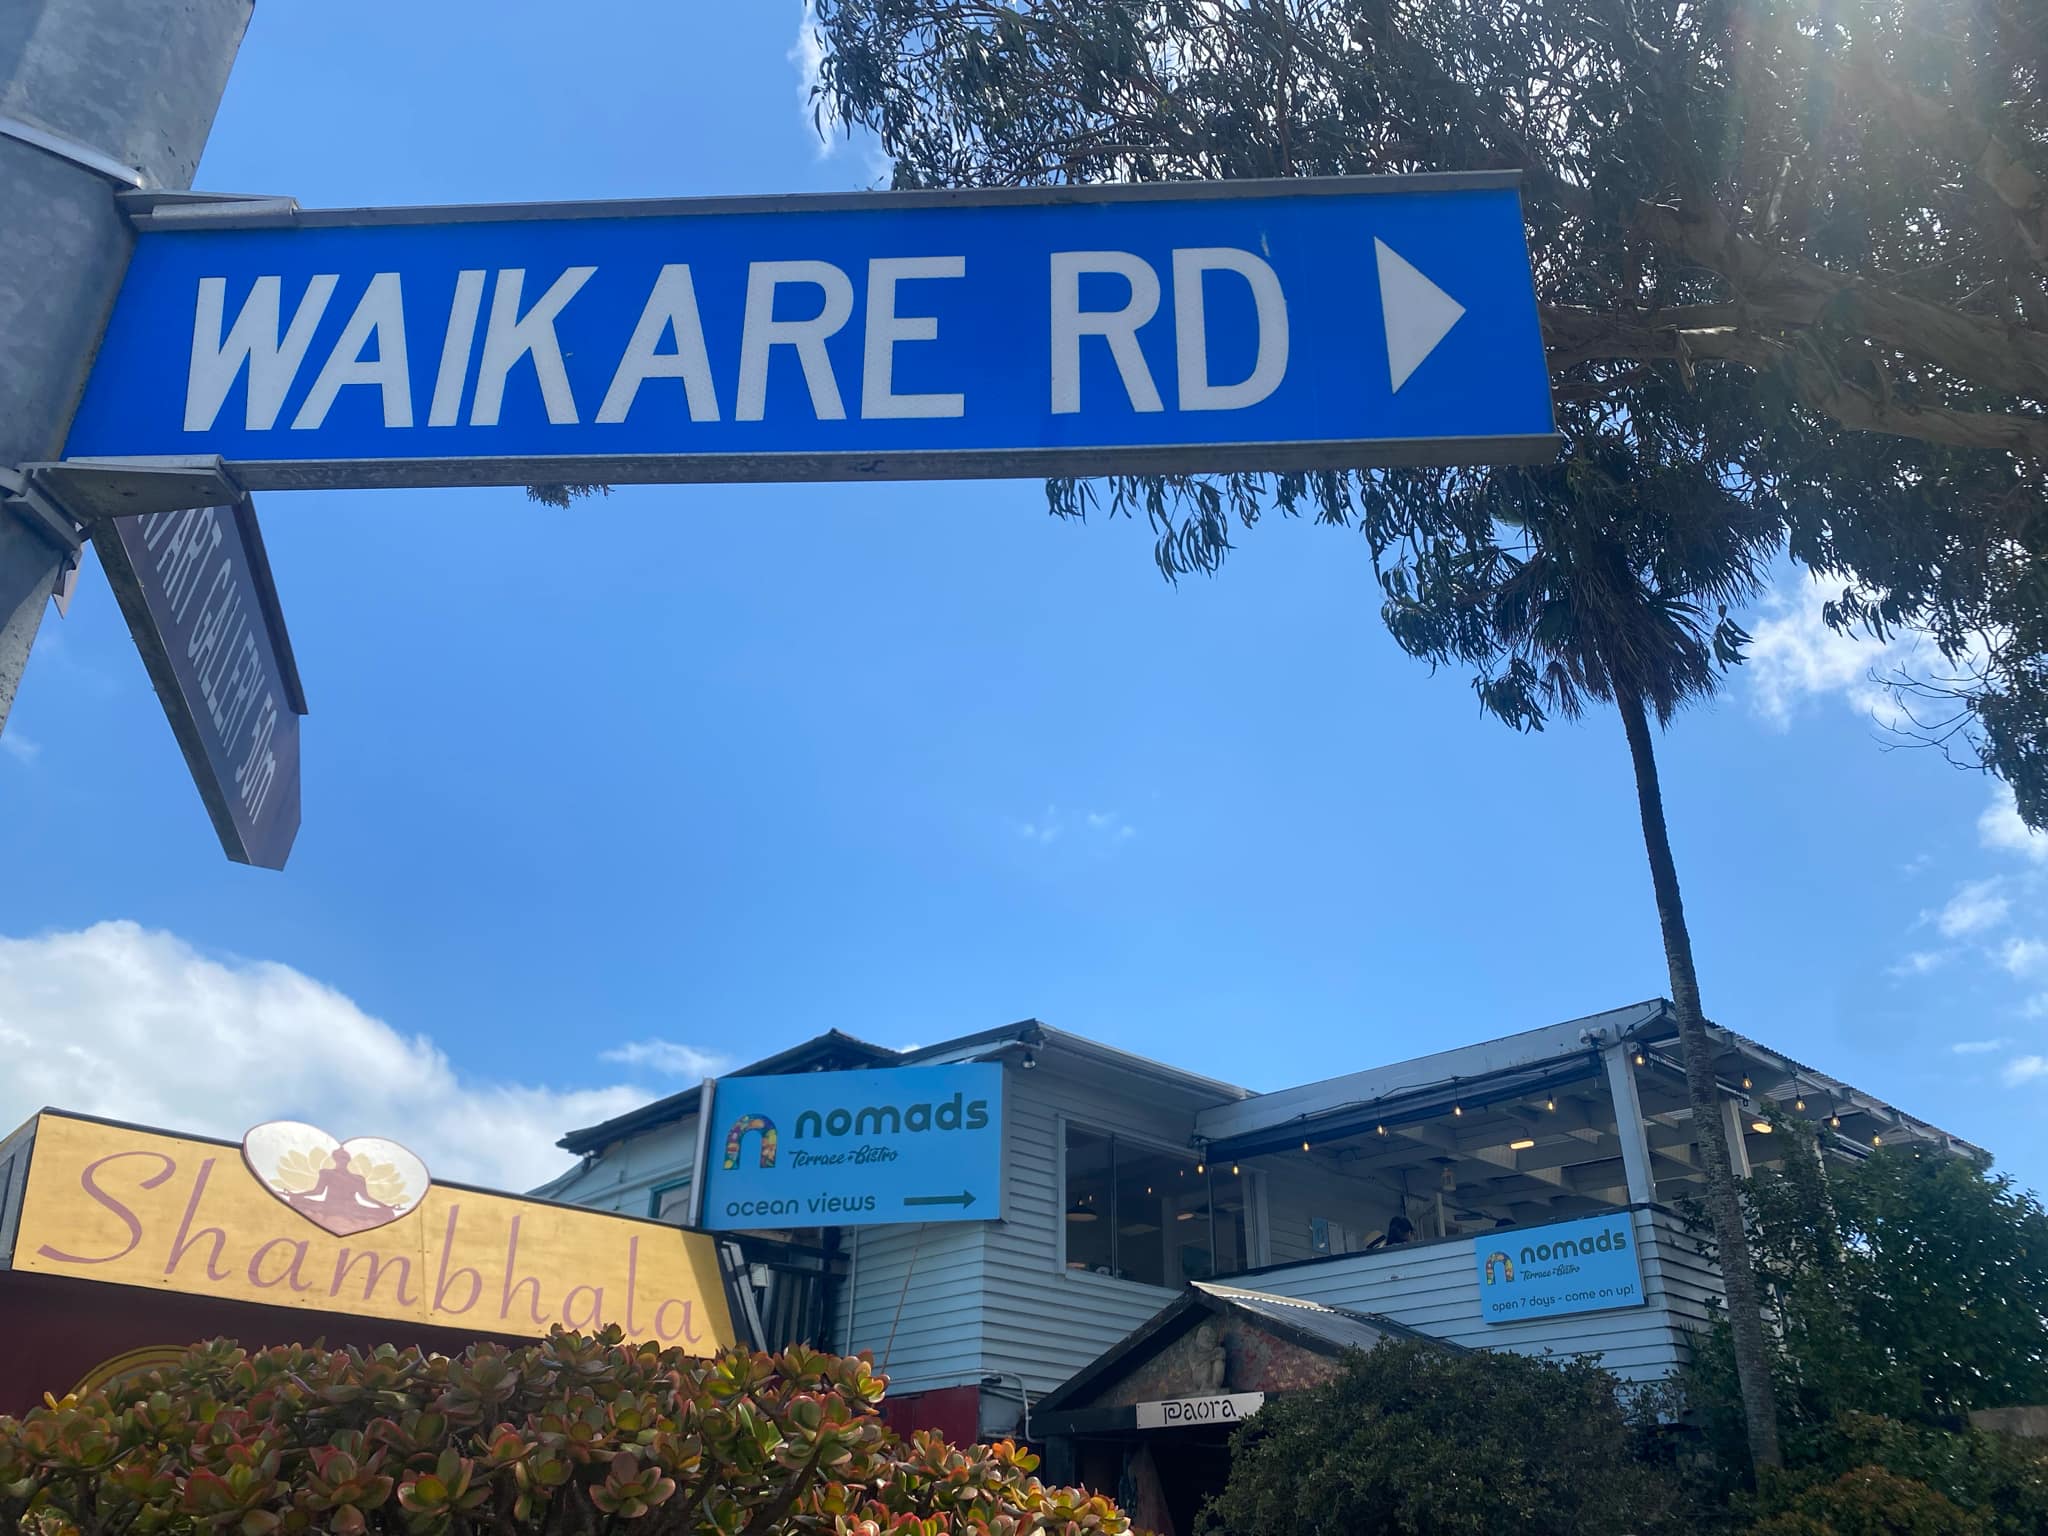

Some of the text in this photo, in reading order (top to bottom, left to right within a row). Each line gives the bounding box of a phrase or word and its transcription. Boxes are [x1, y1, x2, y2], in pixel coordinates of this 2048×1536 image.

[183, 247, 1290, 433] WAIKARE RD
[188, 558, 265, 758] GALLERY
[235, 691, 277, 825] 50m
[795, 1092, 989, 1139] nomads
[726, 1192, 876, 1217] ocean views
[37, 1151, 704, 1344] Shambhala
[1520, 1229, 1627, 1264] nomads
[1492, 1301, 1519, 1313] open
[1521, 1297, 1527, 1307] 7
[1529, 1295, 1556, 1308] days
[1565, 1290, 1596, 1302] come
[1598, 1286, 1614, 1298] on
[1617, 1283, 1635, 1298] up!
[1161, 1399, 1237, 1425] Paora
